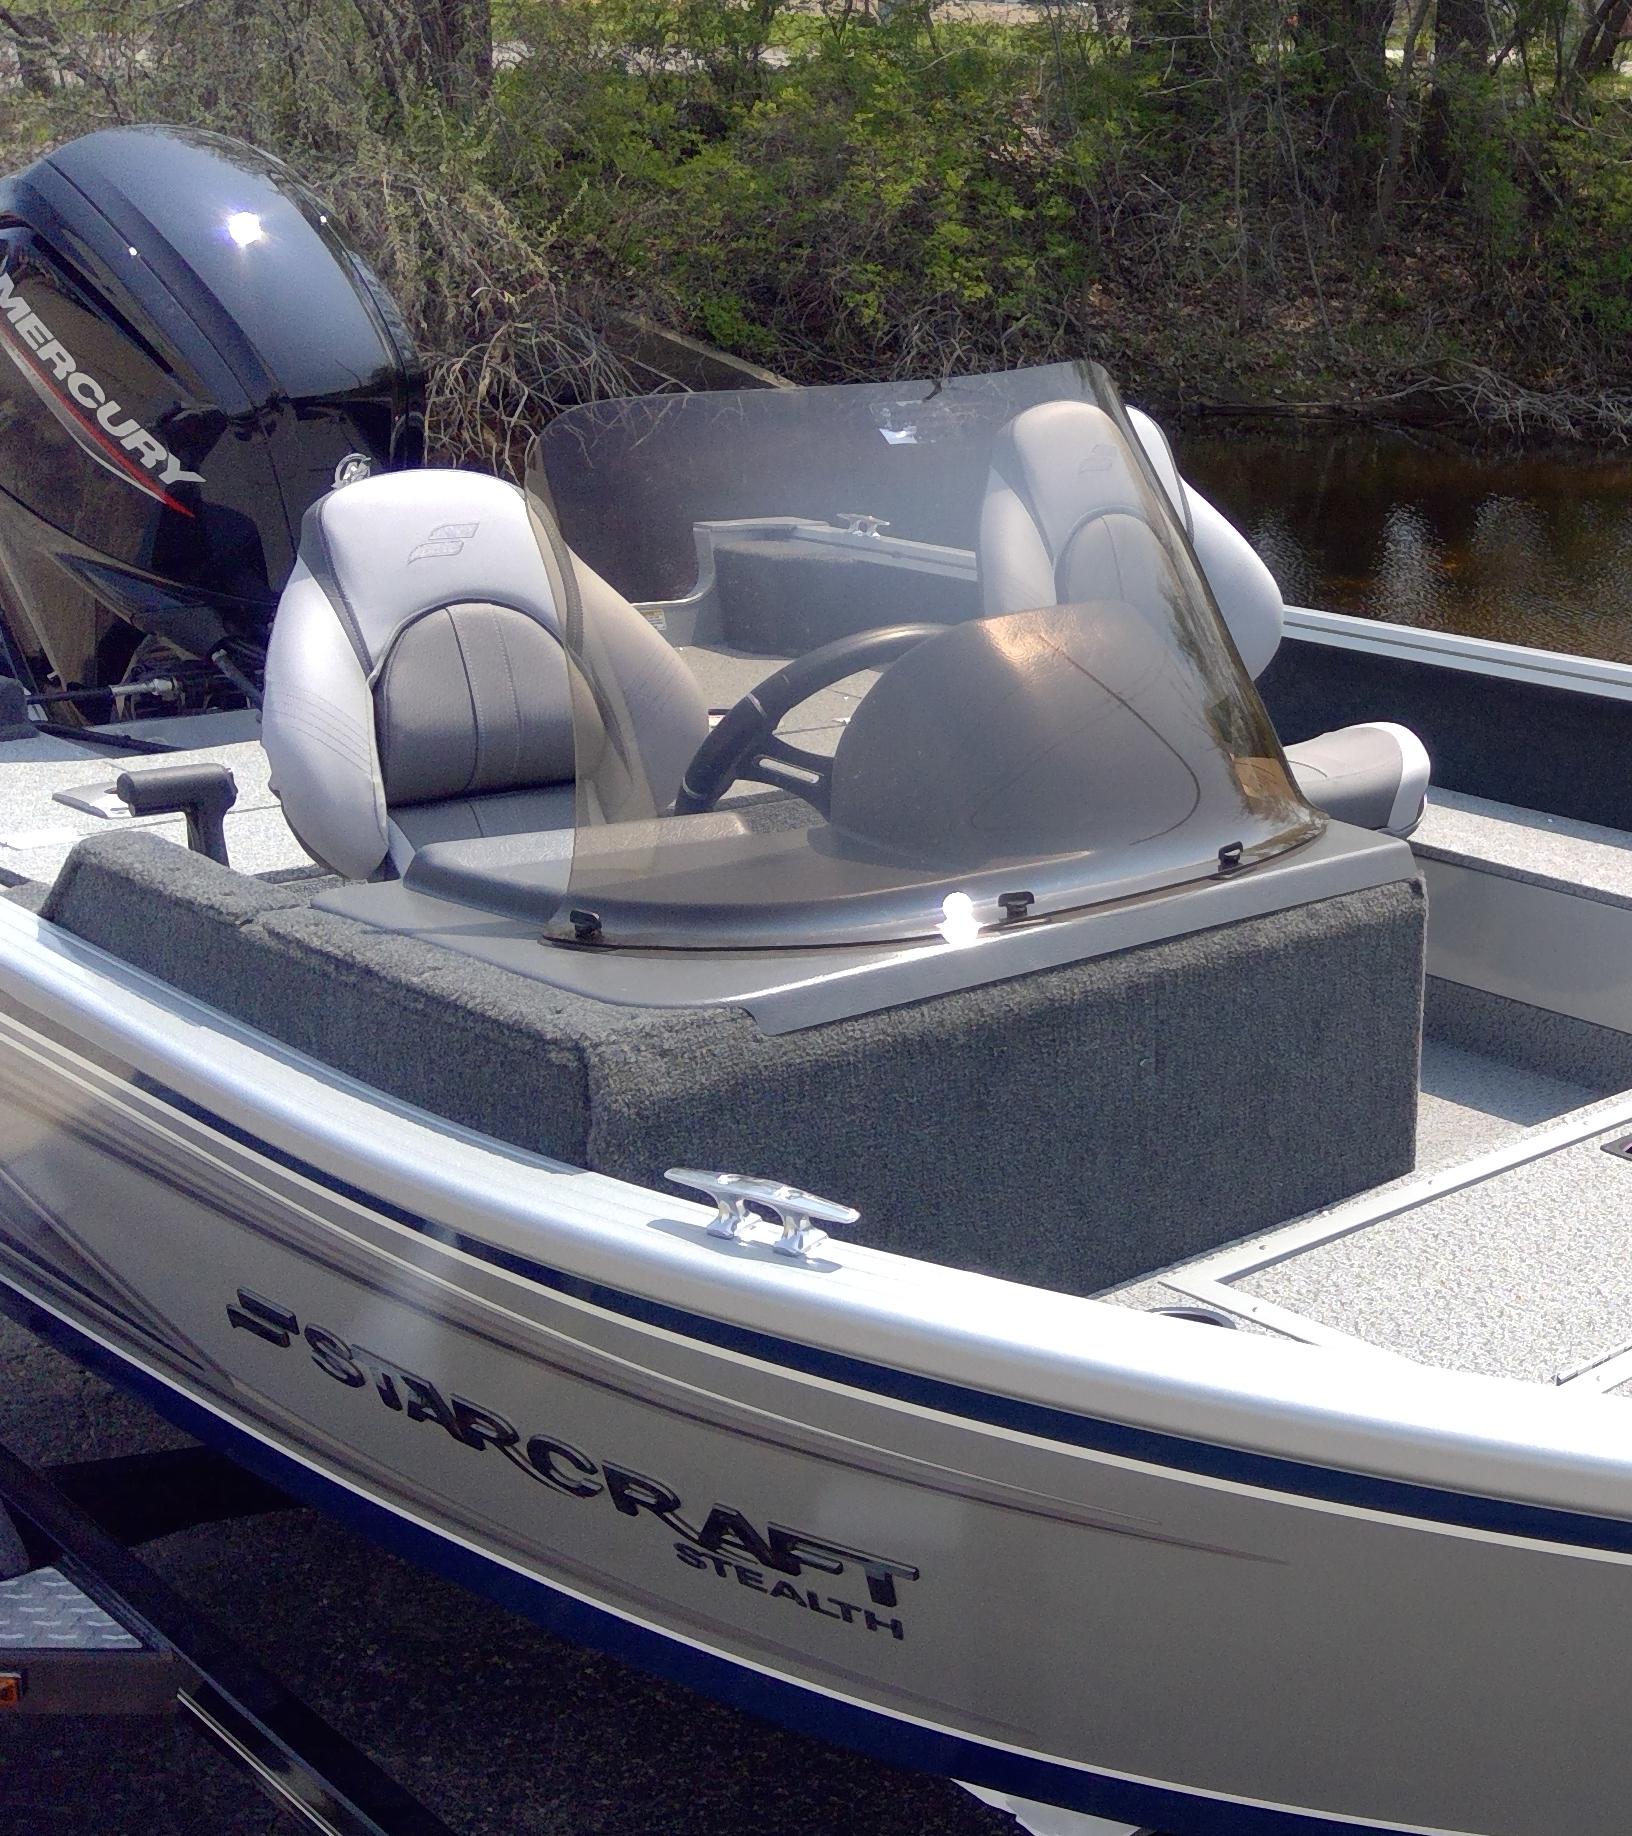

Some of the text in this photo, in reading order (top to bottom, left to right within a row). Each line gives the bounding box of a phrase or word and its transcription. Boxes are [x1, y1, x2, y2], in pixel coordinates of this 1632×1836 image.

[0, 272, 207, 485] MERCURY
[303, 1322, 920, 1608] STARCRAFT
[673, 1541, 905, 1641] STEALTH
